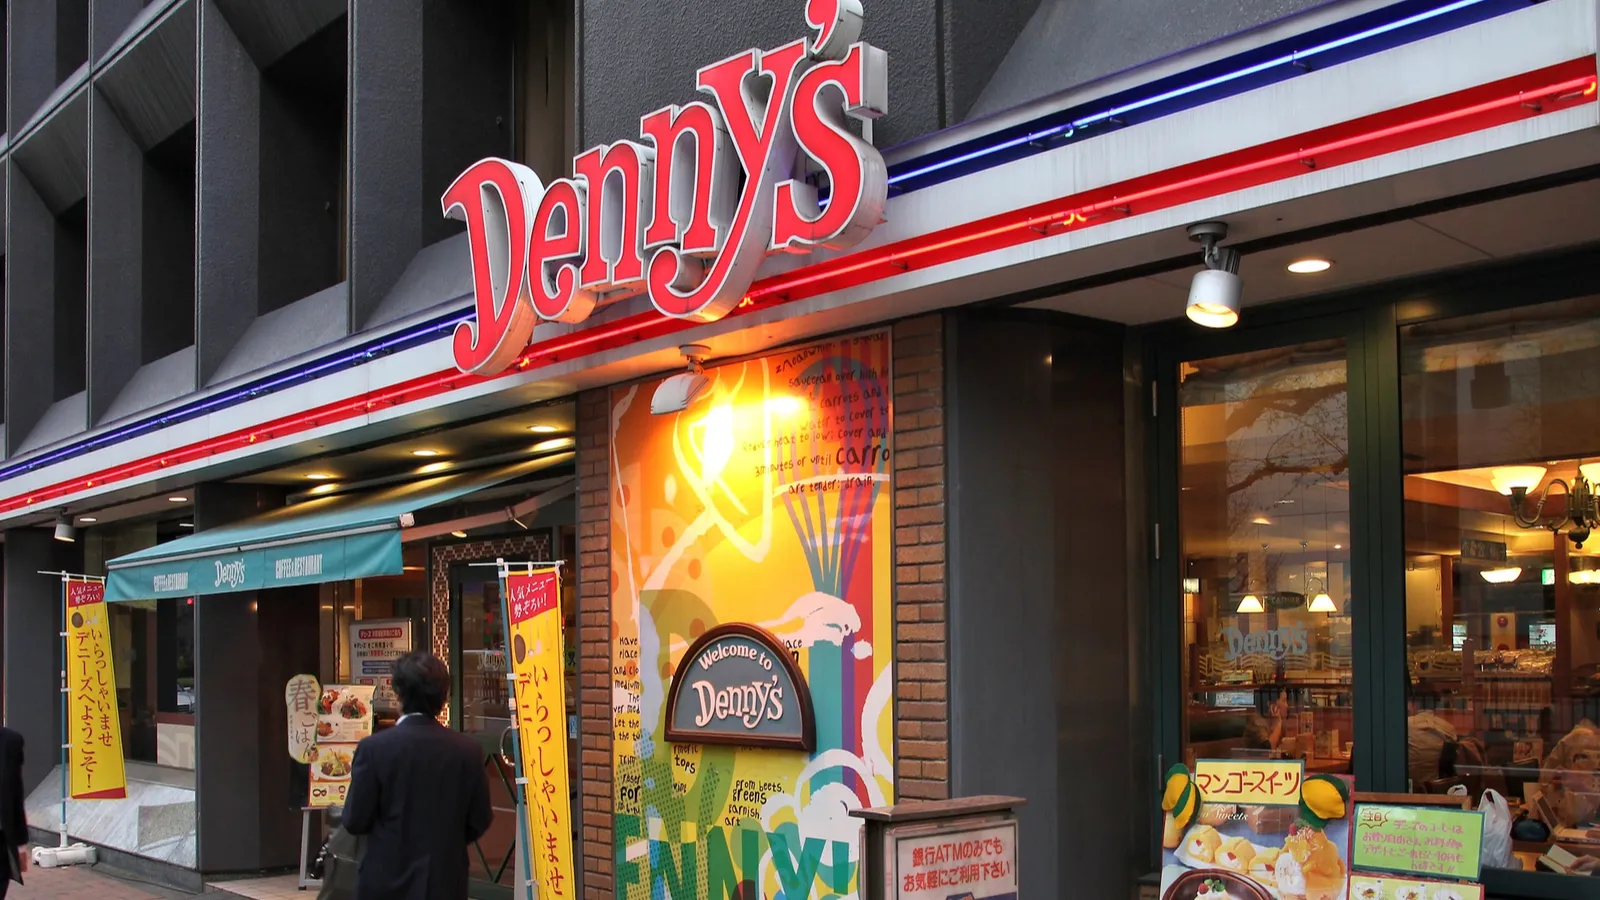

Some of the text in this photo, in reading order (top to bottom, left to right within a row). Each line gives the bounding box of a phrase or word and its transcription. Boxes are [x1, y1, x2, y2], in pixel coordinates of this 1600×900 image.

[441, 0, 878, 375] Denny's
[836, 412, 845, 425] to
[849, 407, 874, 422] cover
[800, 432, 809, 442] to
[838, 428, 864, 438] cover
[868, 427, 886, 438] and
[797, 456, 807, 467] or
[811, 454, 832, 466] until
[836, 444, 890, 466] carro
[789, 483, 805, 495] are
[214, 558, 246, 588] Denny's
[510, 577, 554, 603] 人気メニュー
[619, 637, 638, 646] Have
[1221, 620, 1308, 661] Denny's
[699, 643, 757, 671] Welcome
[758, 652, 772, 671] to
[613, 666, 626, 676] and
[91, 628, 113, 747] いらっしゃいませ
[615, 680, 640, 690] medium
[75, 631, 97, 788] デニーズへようこそ!
[628, 693, 640, 703] The
[692, 674, 784, 729] Denny's
[614, 718, 640, 728] Let the
[533, 665, 565, 896] いらっしゃいませ
[1197, 770, 1300, 796] マンゴースイーツ
[732, 788, 767, 805] greens
[724, 817, 741, 827] art
[1214, 810, 1249, 821] Sweets
[912, 836, 1003, 868] 銀行ATMのみでも
[903, 860, 1010, 893] お気軽にご利用下さい
